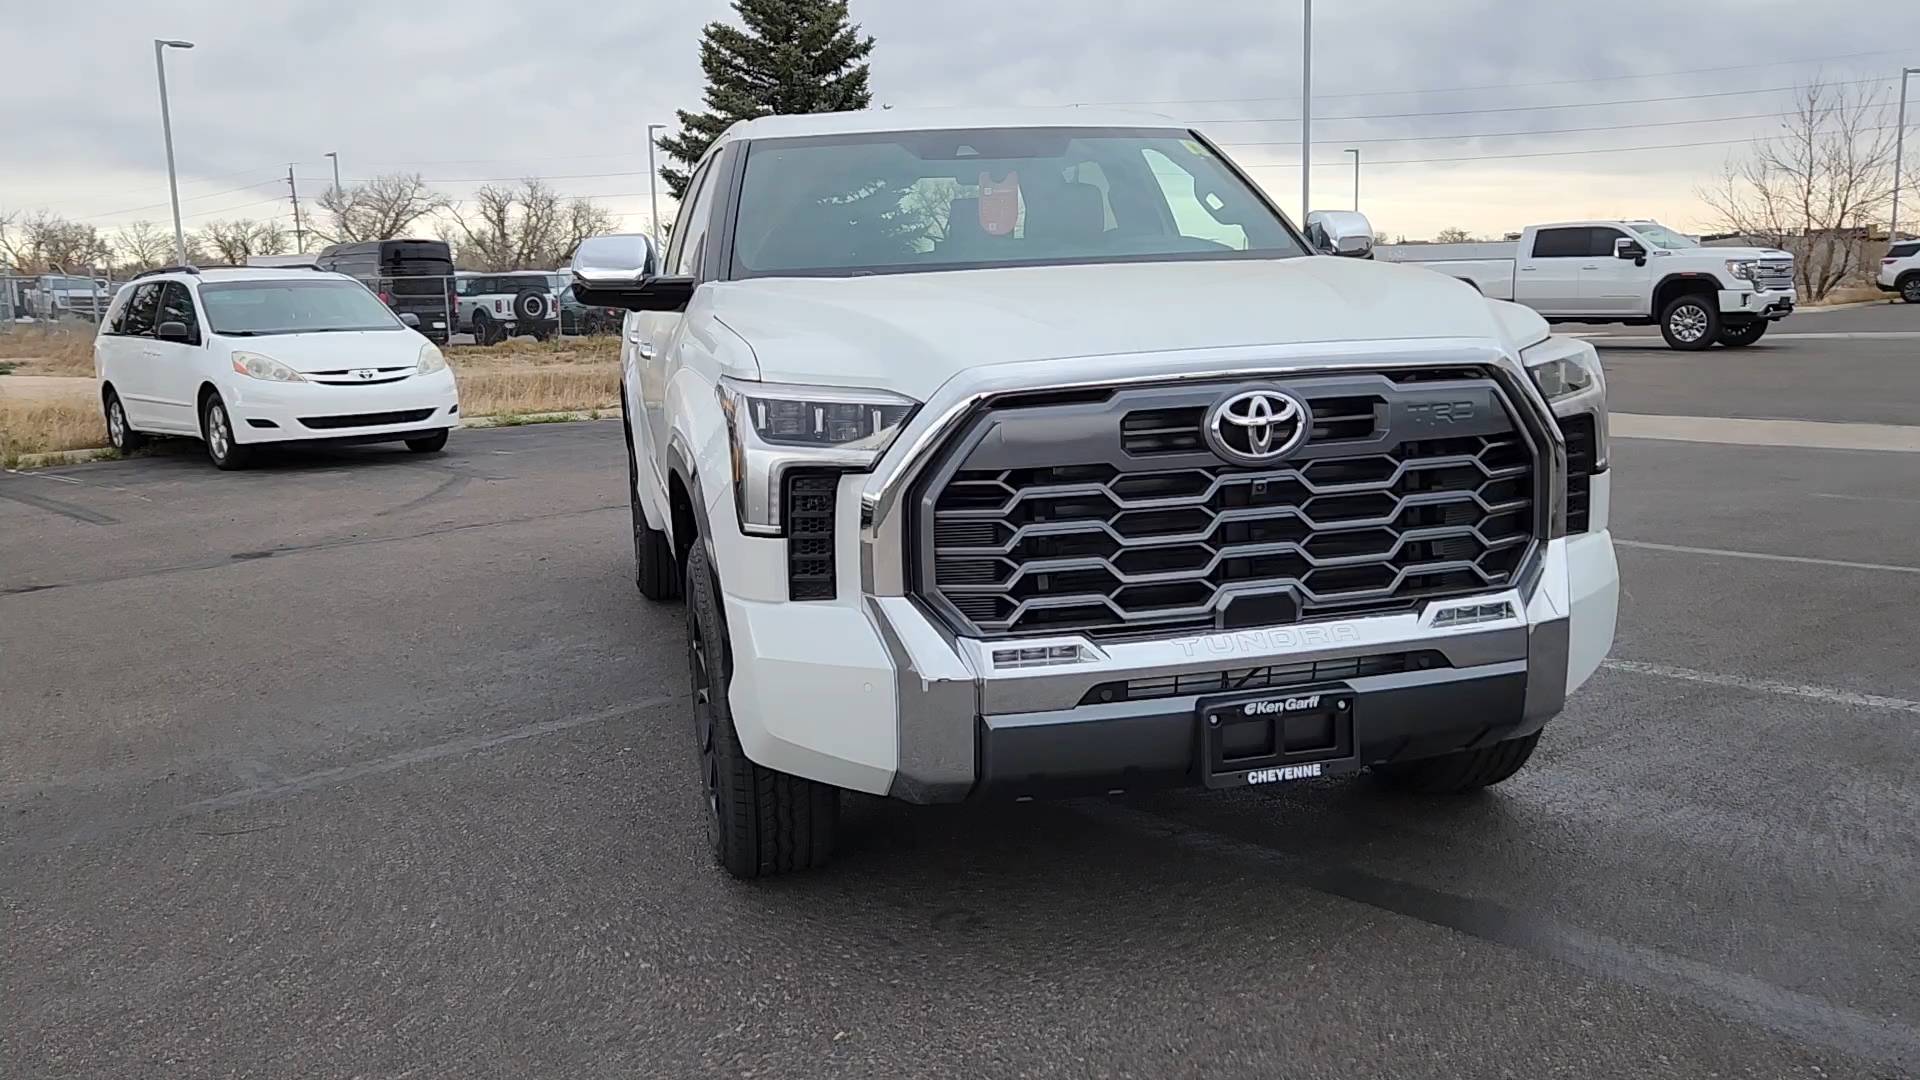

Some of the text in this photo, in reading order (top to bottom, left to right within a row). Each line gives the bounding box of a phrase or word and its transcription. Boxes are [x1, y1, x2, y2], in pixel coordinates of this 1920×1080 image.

[1406, 401, 1475, 425] TRD
[1173, 624, 1360, 657] TUNDRA
[1256, 695, 1320, 715] Ken Garff
[1247, 763, 1322, 785] CHEYENNE
